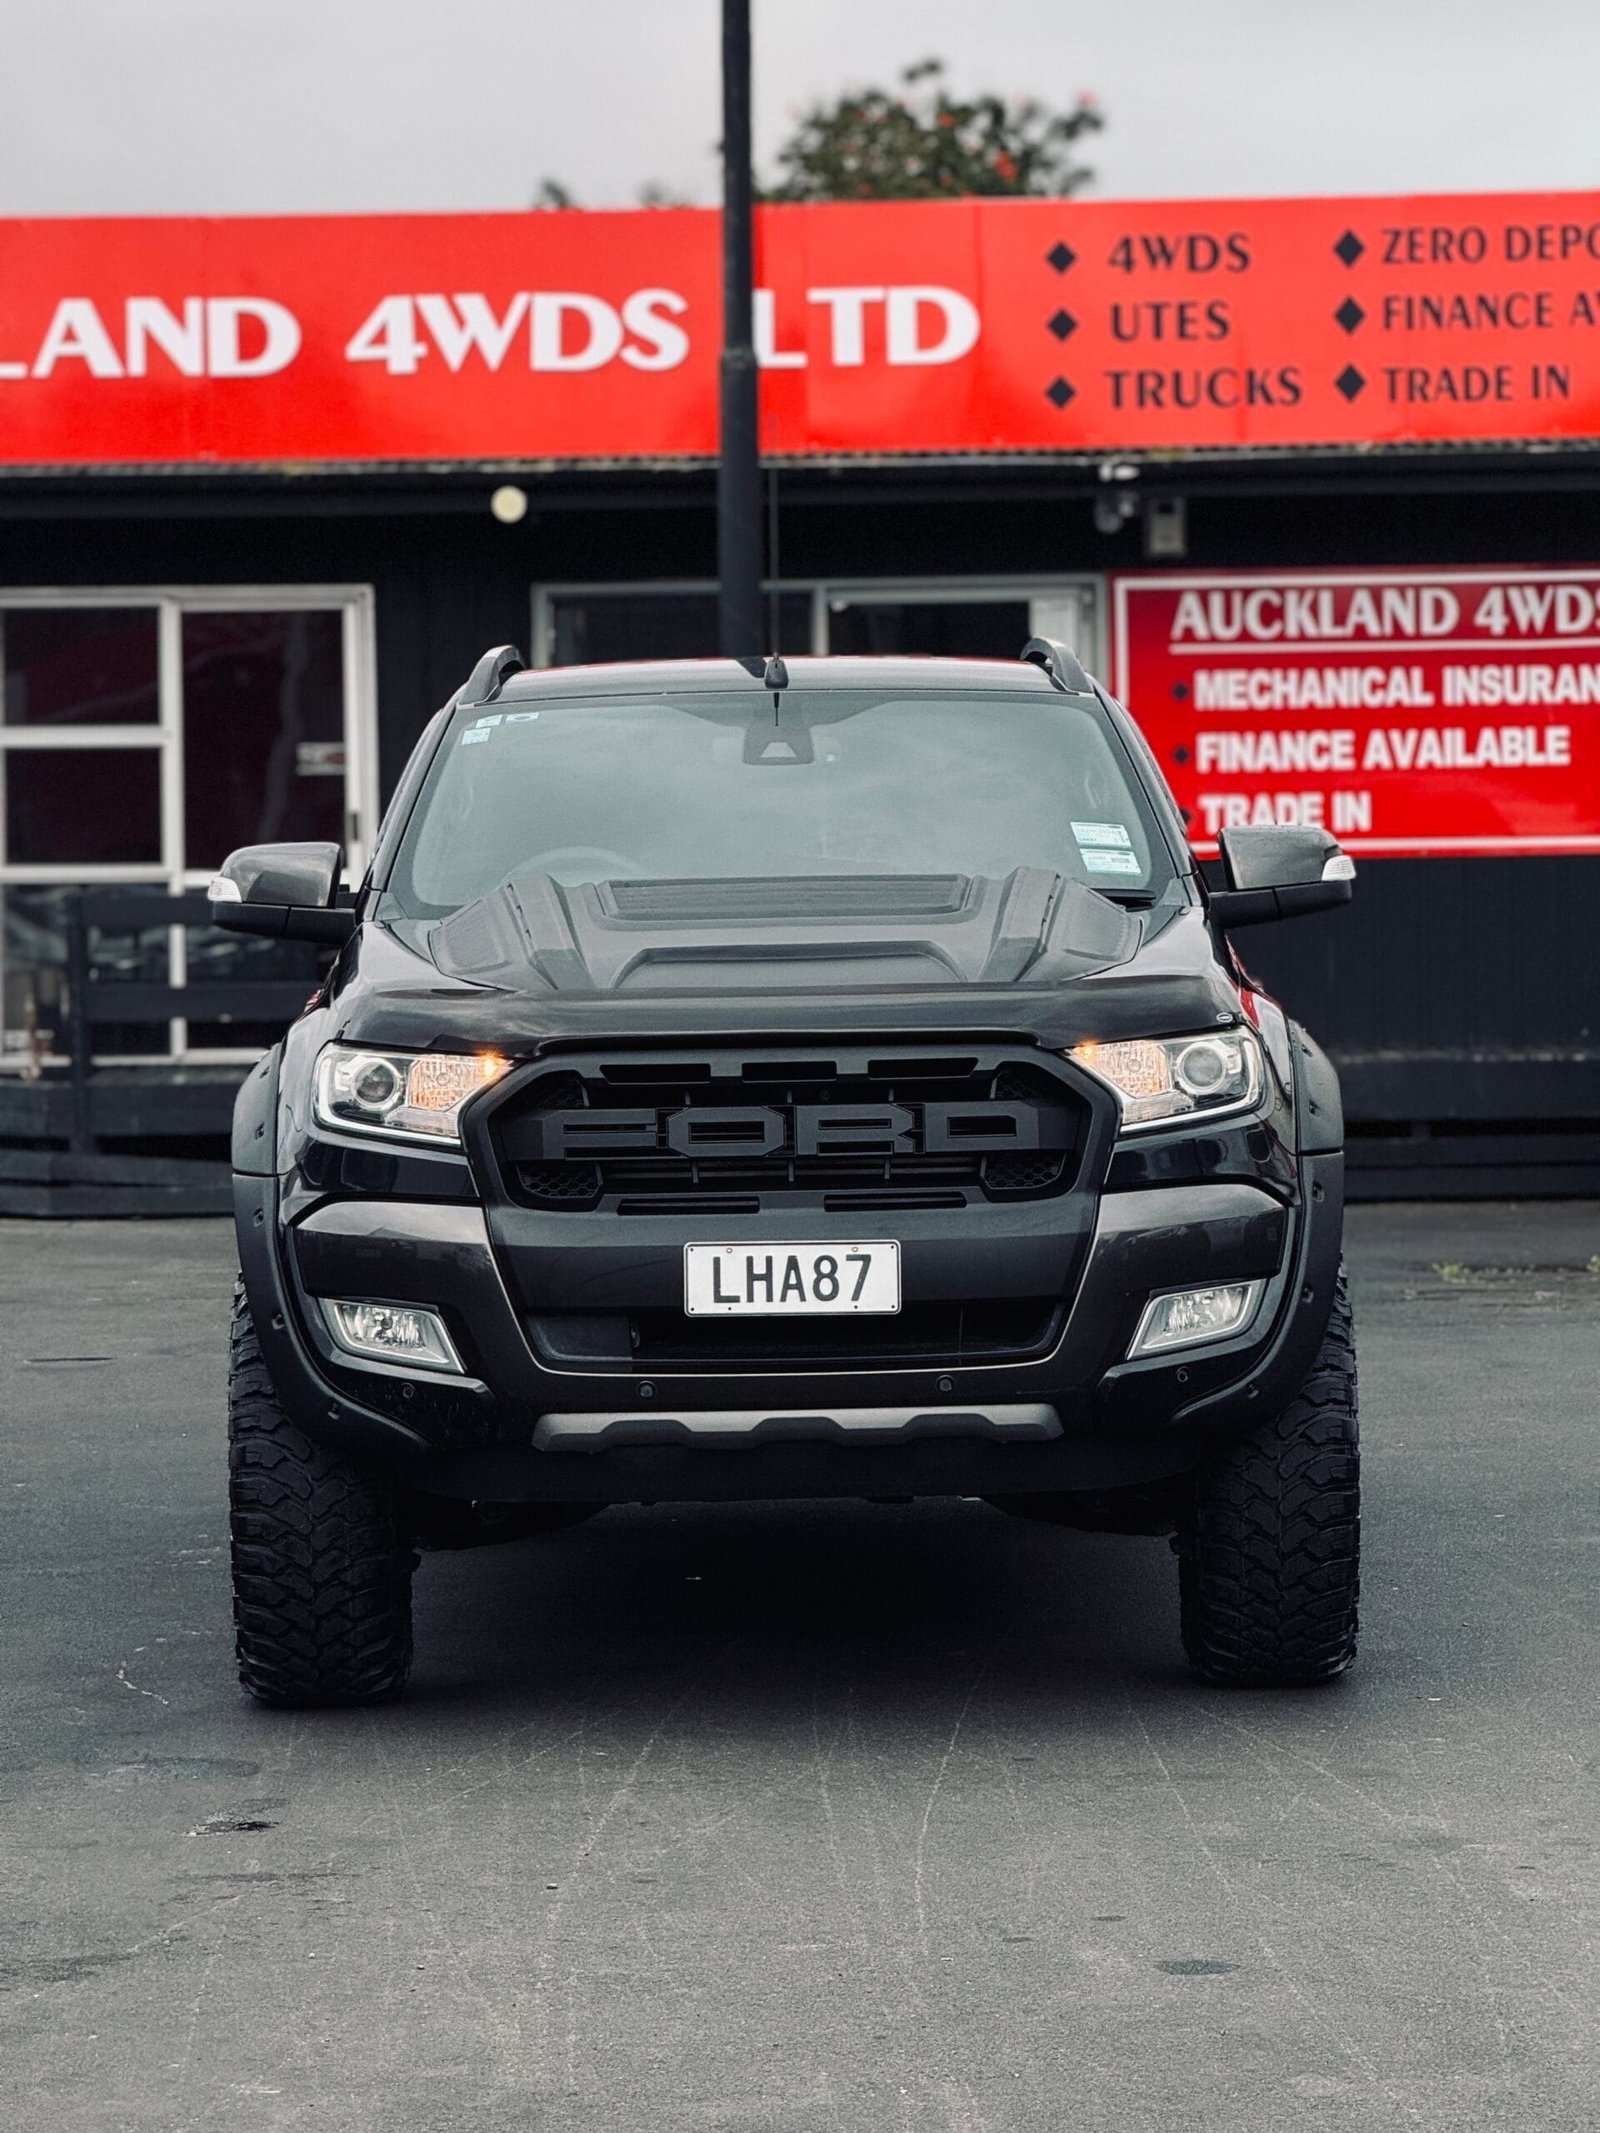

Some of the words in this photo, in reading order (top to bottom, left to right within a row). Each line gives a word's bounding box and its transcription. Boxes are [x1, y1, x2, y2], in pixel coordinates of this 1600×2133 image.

[1107, 233, 1251, 274] 4WDS
[1382, 226, 1488, 265] ZERO
[345, 288, 690, 375] 4WDS
[754, 285, 980, 369] LTD
[1110, 301, 1231, 342] UTES
[1383, 291, 1553, 330] FINANCE
[1105, 366, 1303, 409] TRUCKS
[1383, 365, 1512, 403] TRADE
[1531, 364, 1570, 400] IN
[1172, 587, 1459, 640] AUCKLAND
[1474, 585, 1600, 636] 4WD
[1194, 667, 1434, 710] MECHANICAL
[1196, 730, 1356, 773] FINANCE
[1363, 726, 1571, 769] AVAILABLE
[1198, 793, 1324, 834] TRADE
[1331, 791, 1371, 832] IN
[543, 1104, 1038, 1159] FORD
[712, 1253, 872, 1303] LHA87
